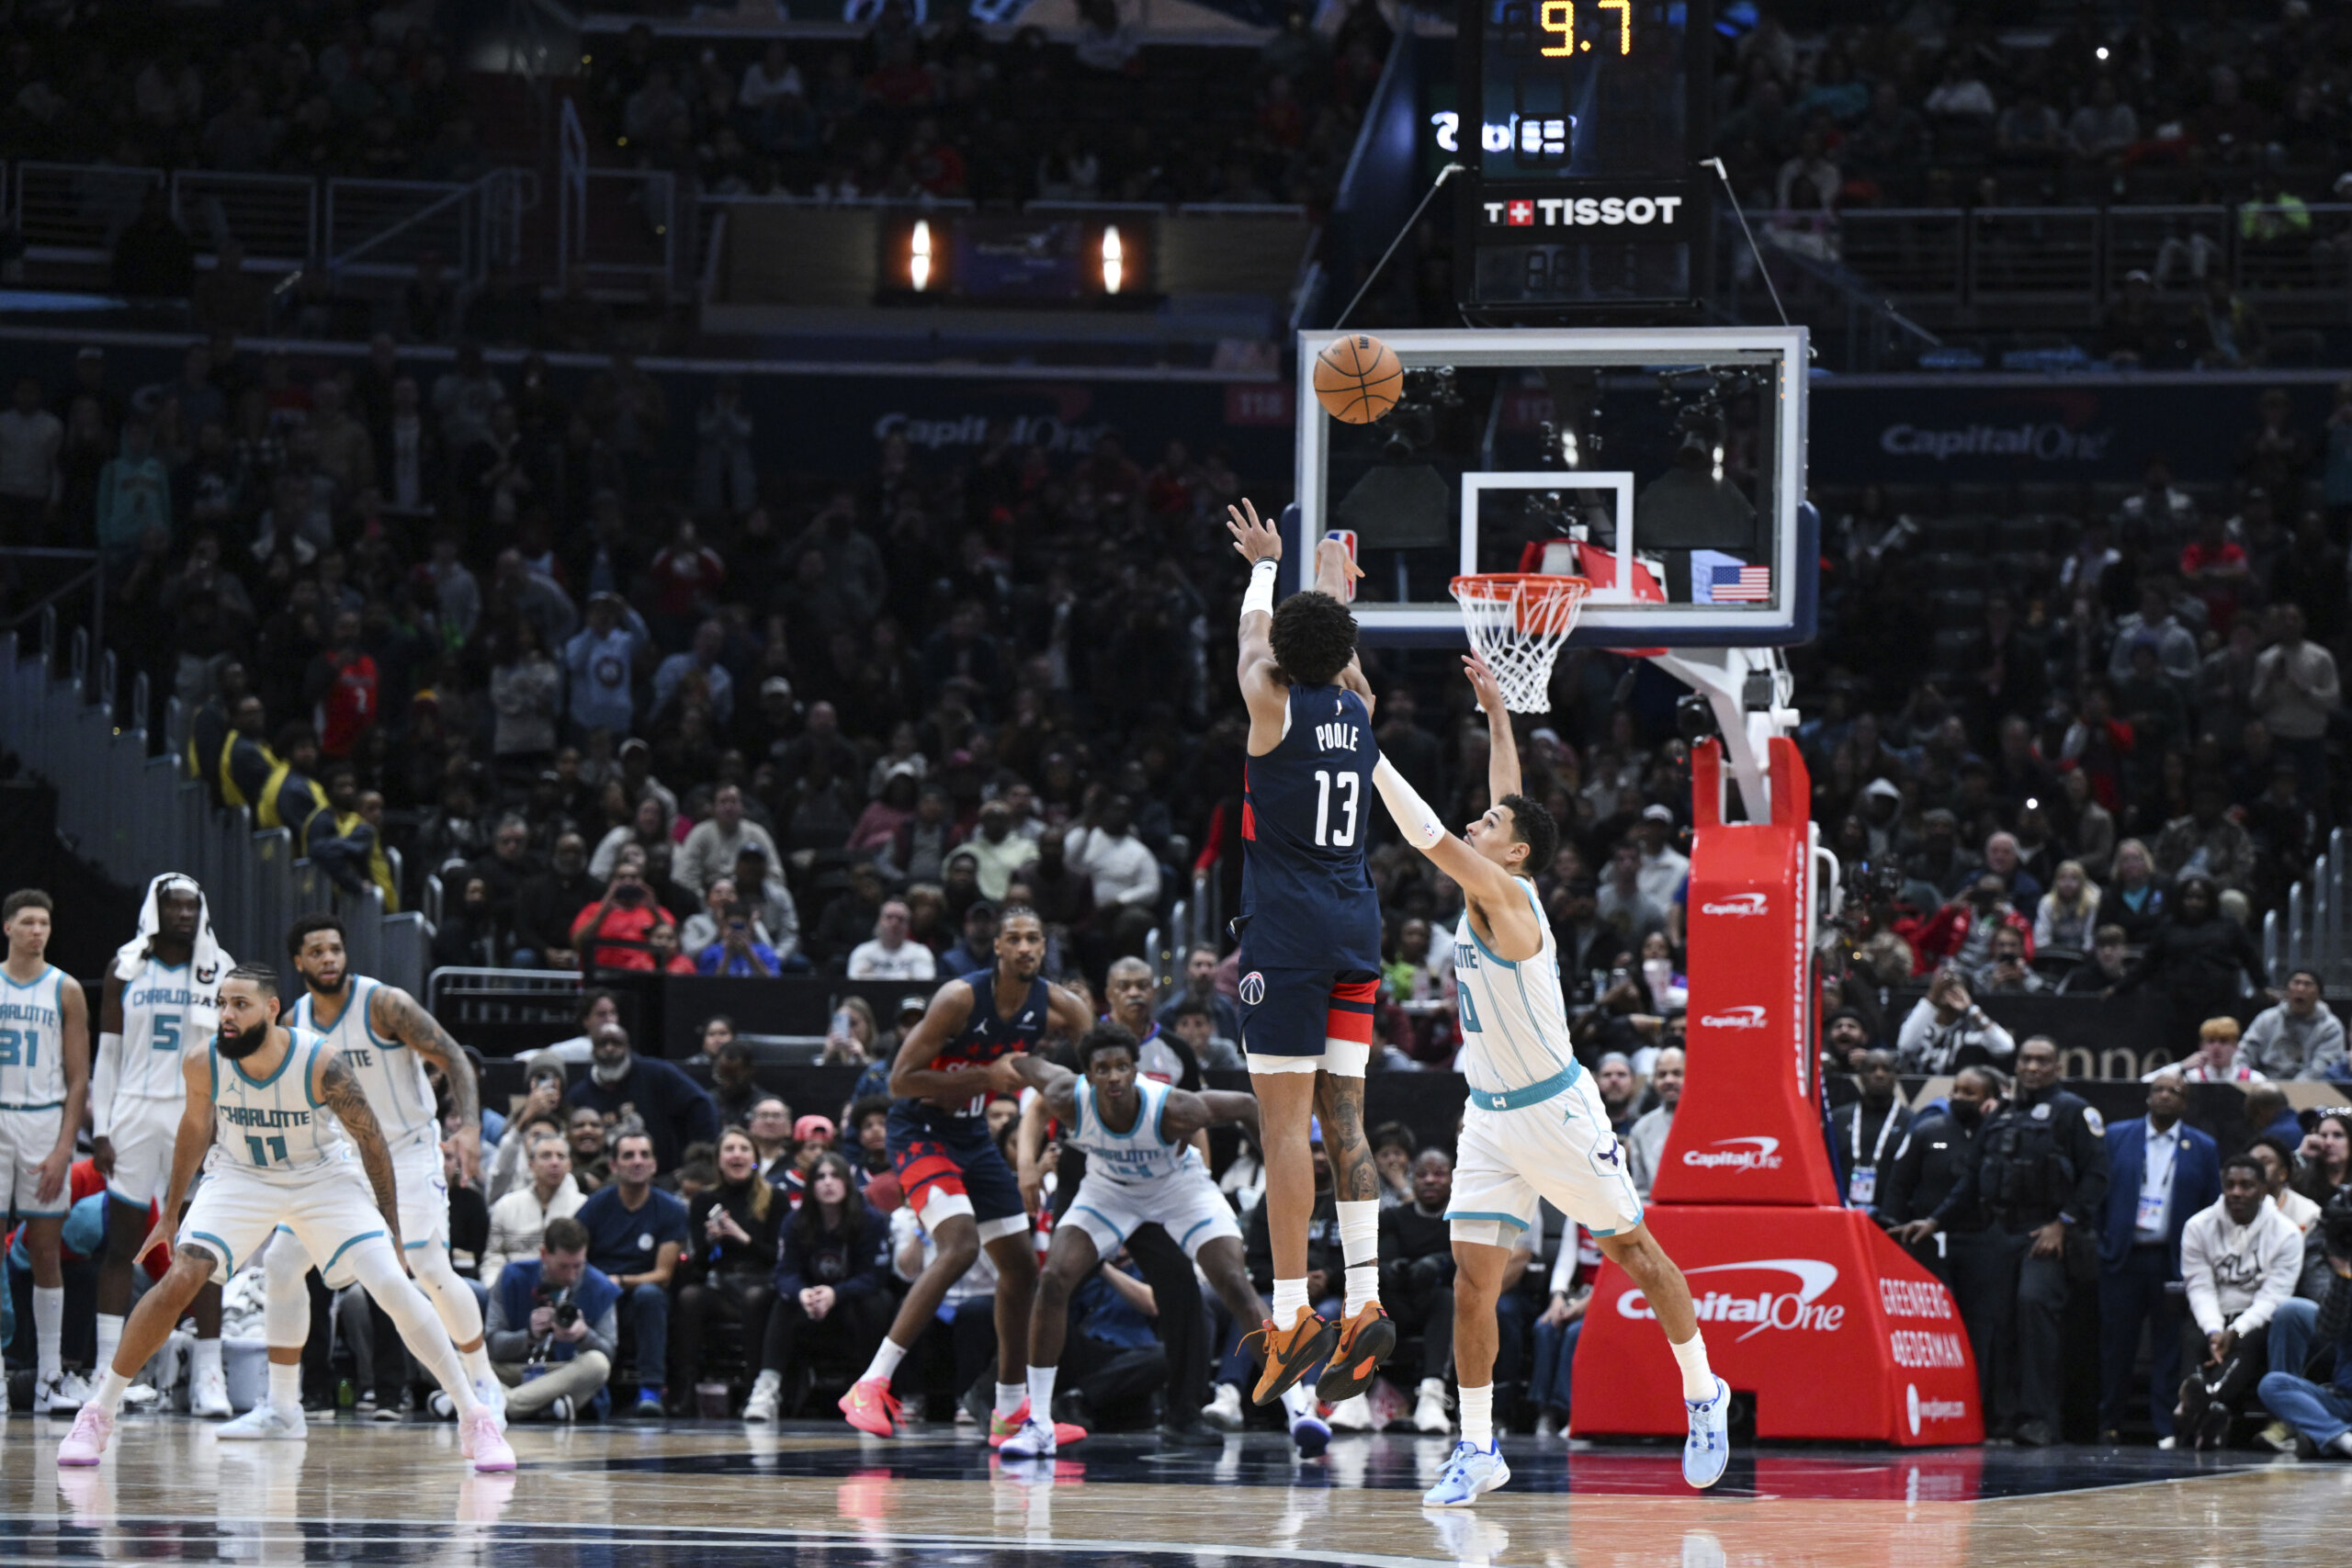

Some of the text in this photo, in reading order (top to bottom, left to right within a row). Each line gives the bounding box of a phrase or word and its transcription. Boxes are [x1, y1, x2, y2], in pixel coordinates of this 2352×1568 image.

[1540, 0, 1631, 57] 9.7
[1537, 197, 1681, 226] TISSOT
[1315, 722, 1360, 752] POOLE
[1315, 770, 1360, 847] 13
[153, 1014, 181, 1050] 5
[219, 1105, 311, 1128] CHARLOTTE
[244, 1134, 289, 1167] 11
[1879, 1278, 1952, 1320] GREENBERG
